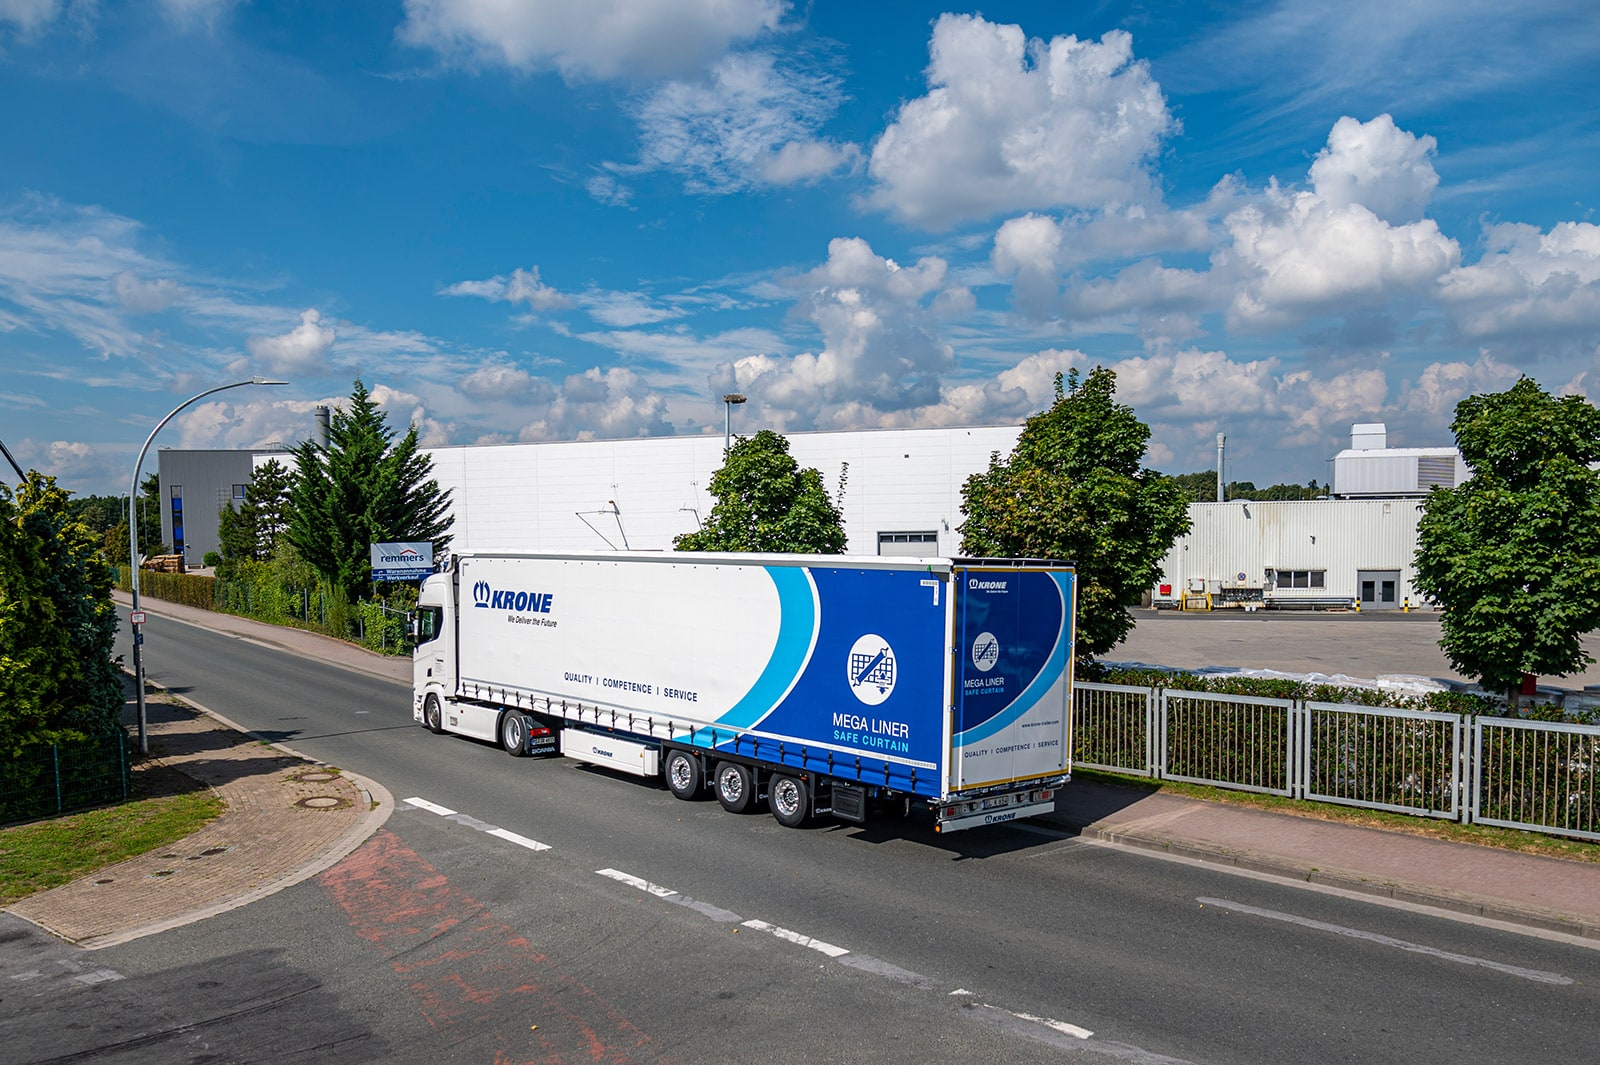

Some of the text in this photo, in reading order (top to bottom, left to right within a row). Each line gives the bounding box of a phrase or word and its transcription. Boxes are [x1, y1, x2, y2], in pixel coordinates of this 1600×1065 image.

[380, 554, 425, 563] remmers
[978, 581, 1007, 589] KRONE
[491, 590, 553, 613] KRONE
[508, 615, 557, 627] We Deliver the Future
[564, 672, 698, 702] QUALITY COMPETENCE SERVICE
[964, 677, 1004, 688] MEGA LINER
[833, 712, 909, 739] MEGA LINER
[833, 730, 909, 753] SAFE CURTAIN
[531, 746, 556, 755] SCANIA
[597, 749, 613, 758] KRONE
[964, 740, 1059, 758] QUALITY COMPETENCE SERVICE
[992, 812, 1017, 823] KRONE
